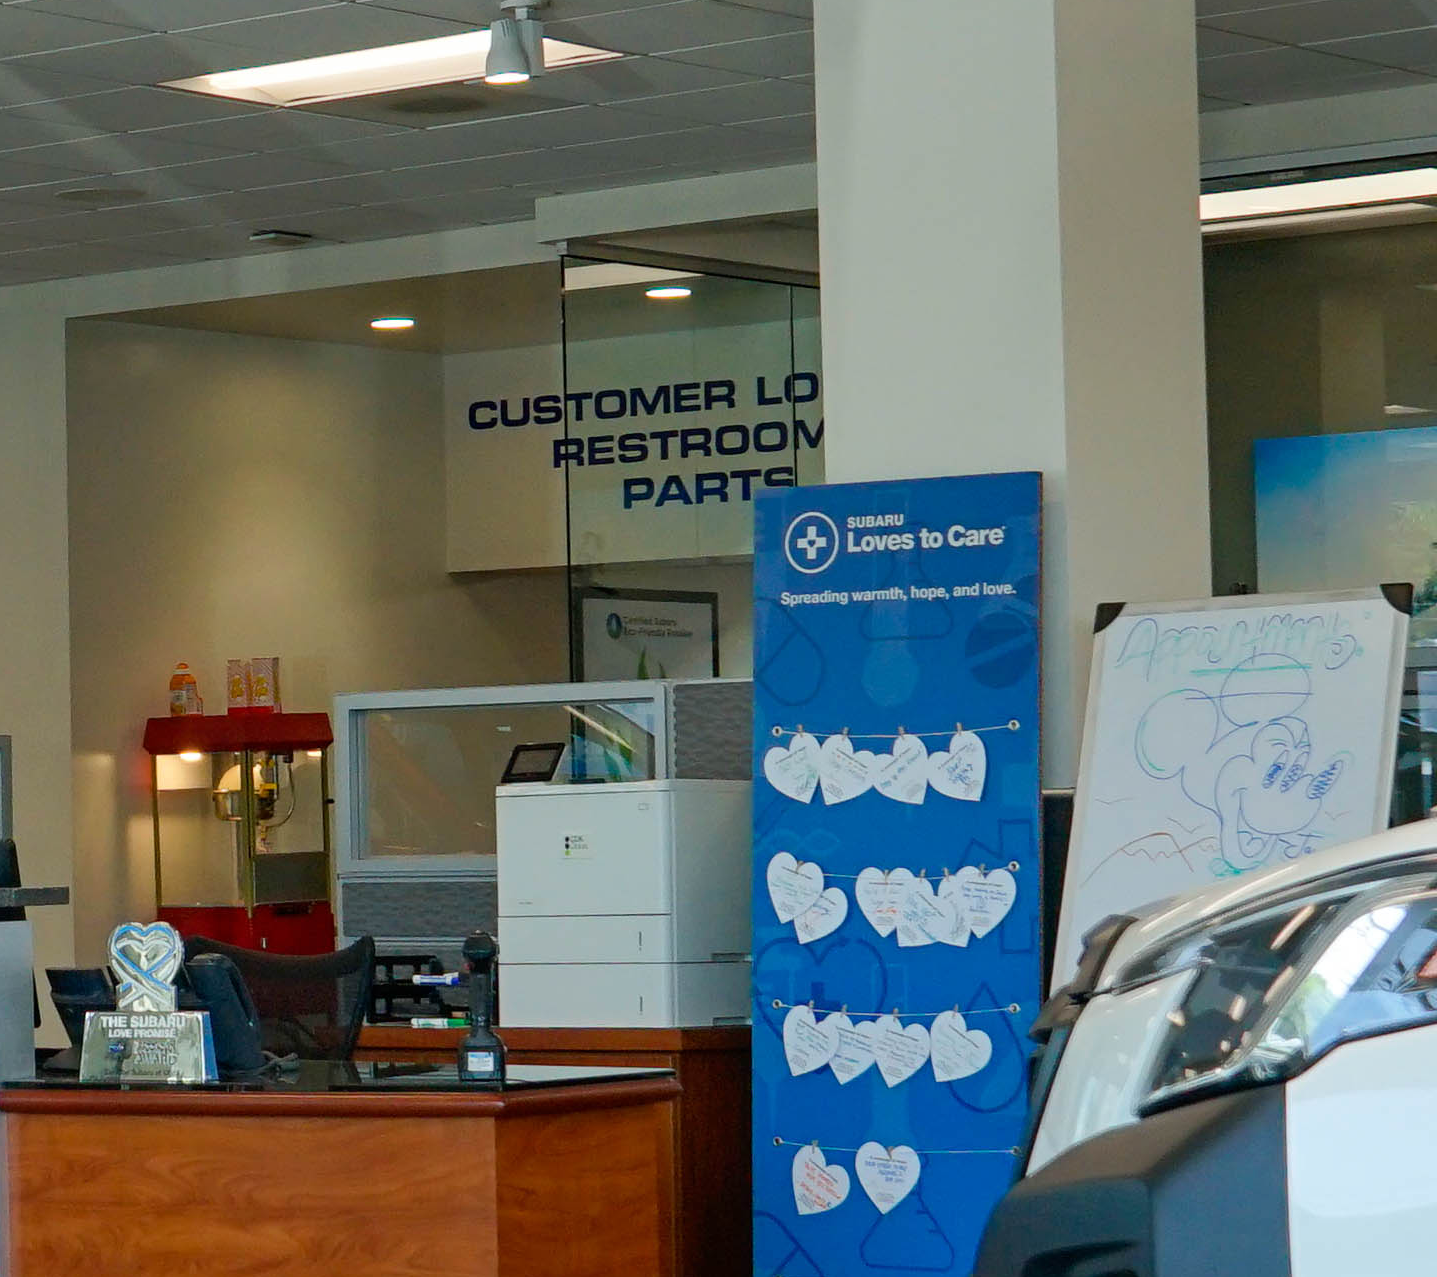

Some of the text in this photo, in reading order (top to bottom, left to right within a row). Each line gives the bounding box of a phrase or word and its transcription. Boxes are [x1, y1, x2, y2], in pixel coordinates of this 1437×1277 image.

[468, 379, 736, 430] CUSTOMER
[623, 466, 794, 509] PARTS
[847, 514, 904, 528] SUBARU
[847, 525, 1005, 553] Loves to Care
[781, 582, 1017, 606] Spreading warmth, hope, and love.
[100, 1015, 185, 1027] THE SUBARU
[108, 1028, 176, 1038] LOVE PROMISE
